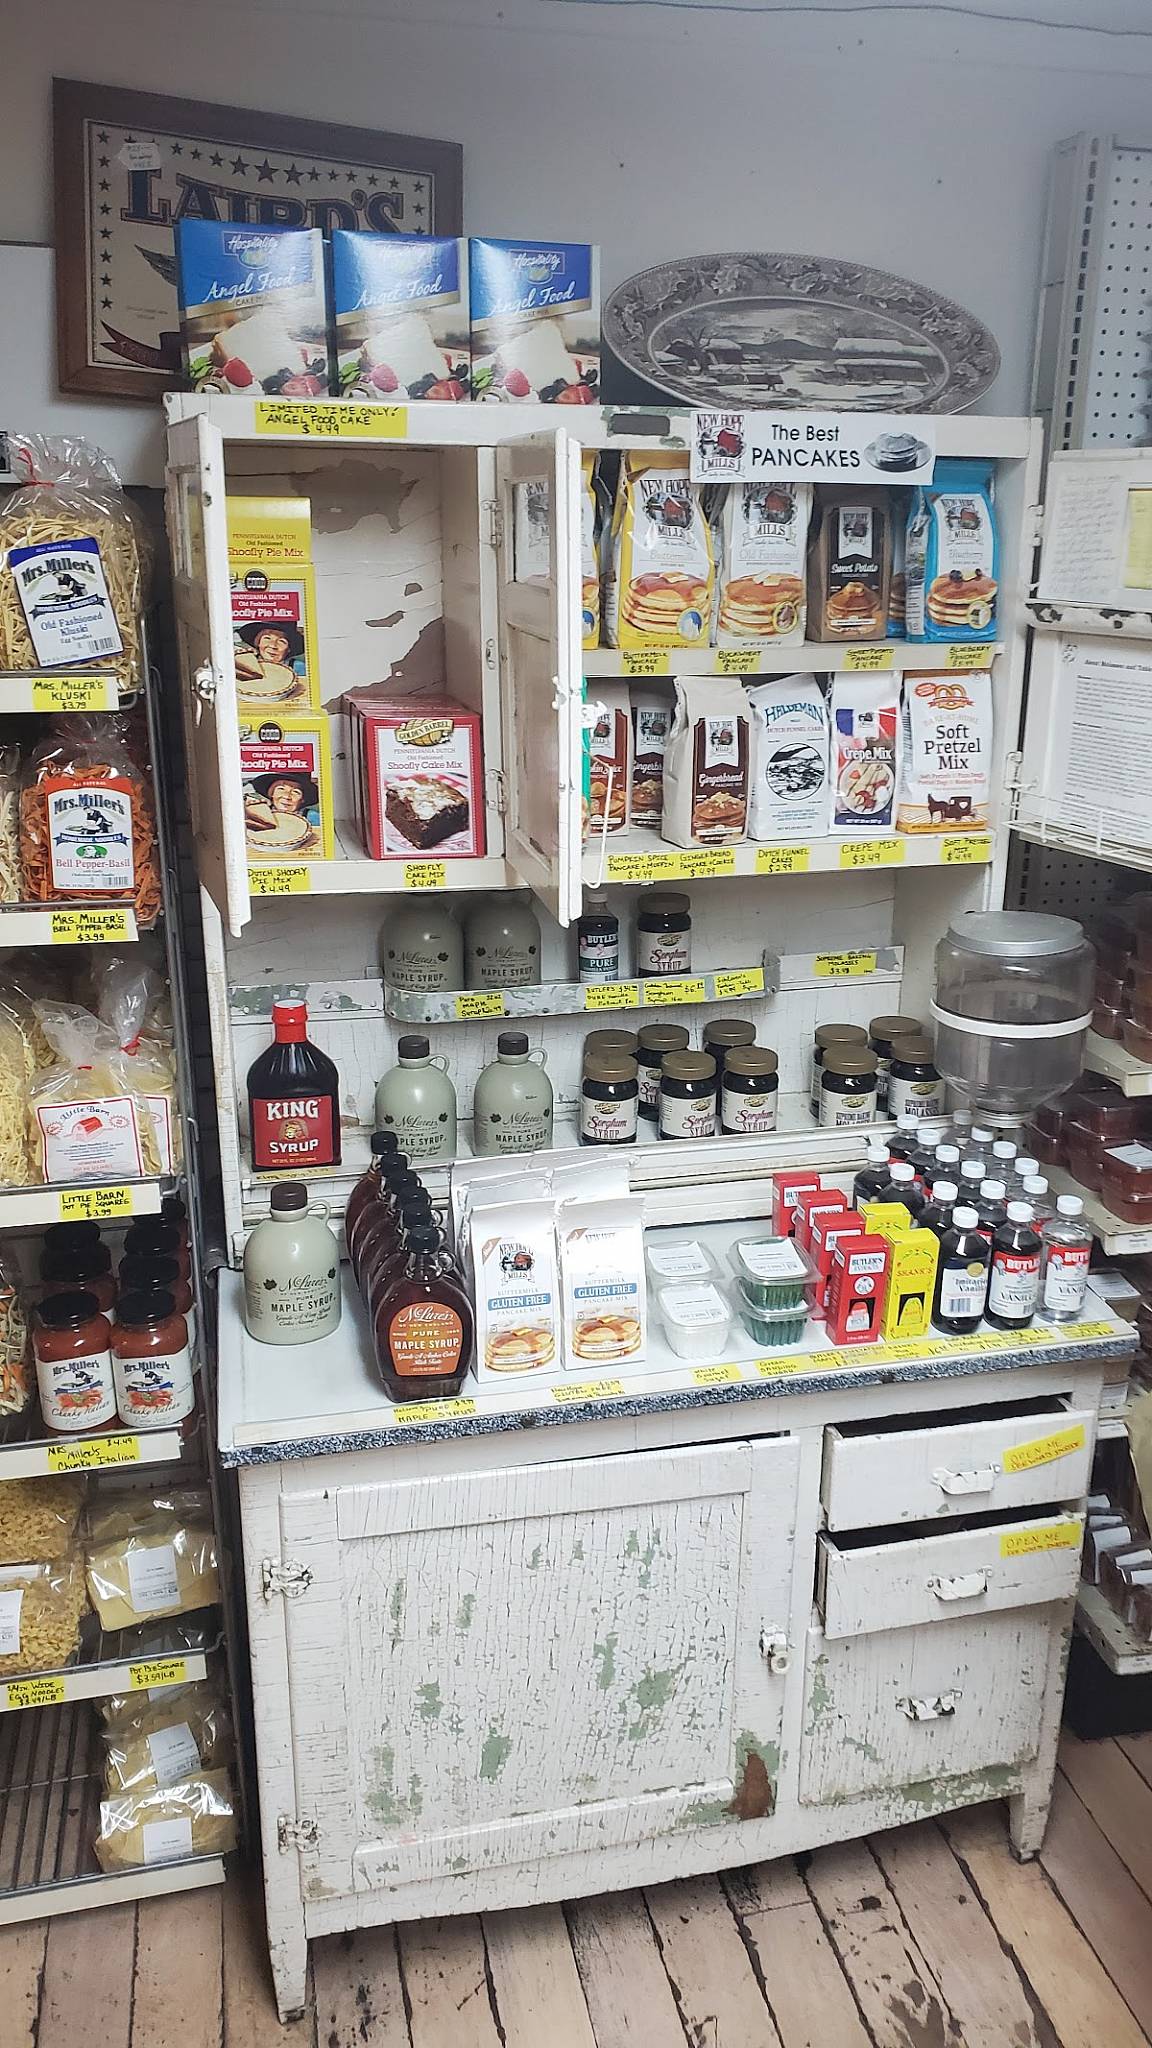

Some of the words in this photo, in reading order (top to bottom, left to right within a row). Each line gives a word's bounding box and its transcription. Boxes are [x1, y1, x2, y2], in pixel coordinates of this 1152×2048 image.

[203, 273, 254, 303] Angel
[258, 267, 296, 291] Food
[407, 274, 443, 298] Food
[539, 281, 576, 305] Food
[260, 402, 318, 414] LIMITED
[323, 406, 355, 415] TIME
[361, 406, 400, 417] ONLY!
[265, 414, 307, 425] ANGEL
[311, 415, 336, 425] FOOD
[340, 415, 371, 425] CAKE
[697, 413, 719, 433] NEW
[720, 414, 745, 434] HOPE
[771, 424, 800, 441] The
[806, 425, 839, 442] Best
[707, 458, 736, 469] MILLS
[752, 447, 861, 468] PANCAKES
[757, 524, 786, 536] MILLS
[266, 547, 282, 557] Pie
[284, 548, 305, 557] Mix
[831, 563, 853, 575] Sweet
[854, 563, 878, 574] Potato
[257, 608, 273, 617] Pie
[273, 609, 294, 617] Mix
[41, 620, 57, 631] Old
[58, 611, 103, 628] Fashioned
[60, 625, 89, 637] Kluski
[629, 665, 655, 674] $3.99
[33, 681, 55, 691] MRS.
[60, 679, 104, 690] MILLER'S
[51, 691, 92, 701] KLUSKI
[62, 701, 87, 710] $3.79
[765, 703, 825, 728] HALDEMAN
[936, 724, 970, 739] Soft
[924, 738, 982, 755] Pretzel
[271, 760, 287, 768] Pie
[287, 760, 309, 768] Mix
[388, 761, 420, 771] Shoofly
[421, 761, 445, 769] Cake
[446, 761, 463, 769] Mix
[938, 755, 969, 770] Mix
[699, 771, 744, 787] Gingerbread
[842, 842, 873, 854] CREPE
[878, 840, 899, 849] MIX
[944, 838, 961, 847] SOFT
[782, 848, 810, 856] FUNNEL
[56, 858, 73, 867] Bell
[76, 858, 130, 870] Pepper-Basil
[608, 854, 644, 863] PUMPKIN
[852, 853, 880, 865] $3.49
[608, 863, 641, 872] PANCAKE
[406, 871, 425, 879] CAKE
[428, 870, 446, 878] MIX
[252, 877, 269, 885] PIE
[52, 914, 78, 925] MRS.
[82, 913, 125, 924] MILLER'S
[53, 925, 72, 933] BELL
[77, 933, 105, 942] $3.99
[650, 949, 688, 964] Sorghum
[590, 958, 615, 968] PURE
[88, 1105, 110, 1117] Barn
[266, 1099, 319, 1121] KING
[735, 1109, 774, 1124] Sorghum
[587, 1115, 628, 1131] Sorghum
[593, 1128, 620, 1139] SYRUP
[690, 1124, 712, 1137] SYRUP
[495, 1133, 523, 1143] MAPLE
[269, 1138, 319, 1154] SYRUP
[62, 1193, 92, 1204] LITTLE
[96, 1190, 125, 1200] BARN
[62, 1203, 76, 1211] POT
[80, 1201, 91, 1209] PIE
[95, 1198, 130, 1208] SQUARES
[86, 1208, 112, 1218] $3.99
[508, 1271, 528, 1279] MILLS
[578, 1285, 612, 1297] GLUTEN
[612, 1283, 633, 1295] FREE
[491, 1296, 525, 1309] GLUTEN
[526, 1293, 547, 1305] FREE
[271, 1302, 304, 1313] MAPLE
[394, 1340, 426, 1350] MAPLE
[1010, 1447, 1042, 1464] OPEN
[1047, 1439, 1062, 1449] ME
[98, 1453, 136, 1466] Italian
[1006, 1535, 1040, 1548] OPEN
[1045, 1532, 1061, 1540] ME
